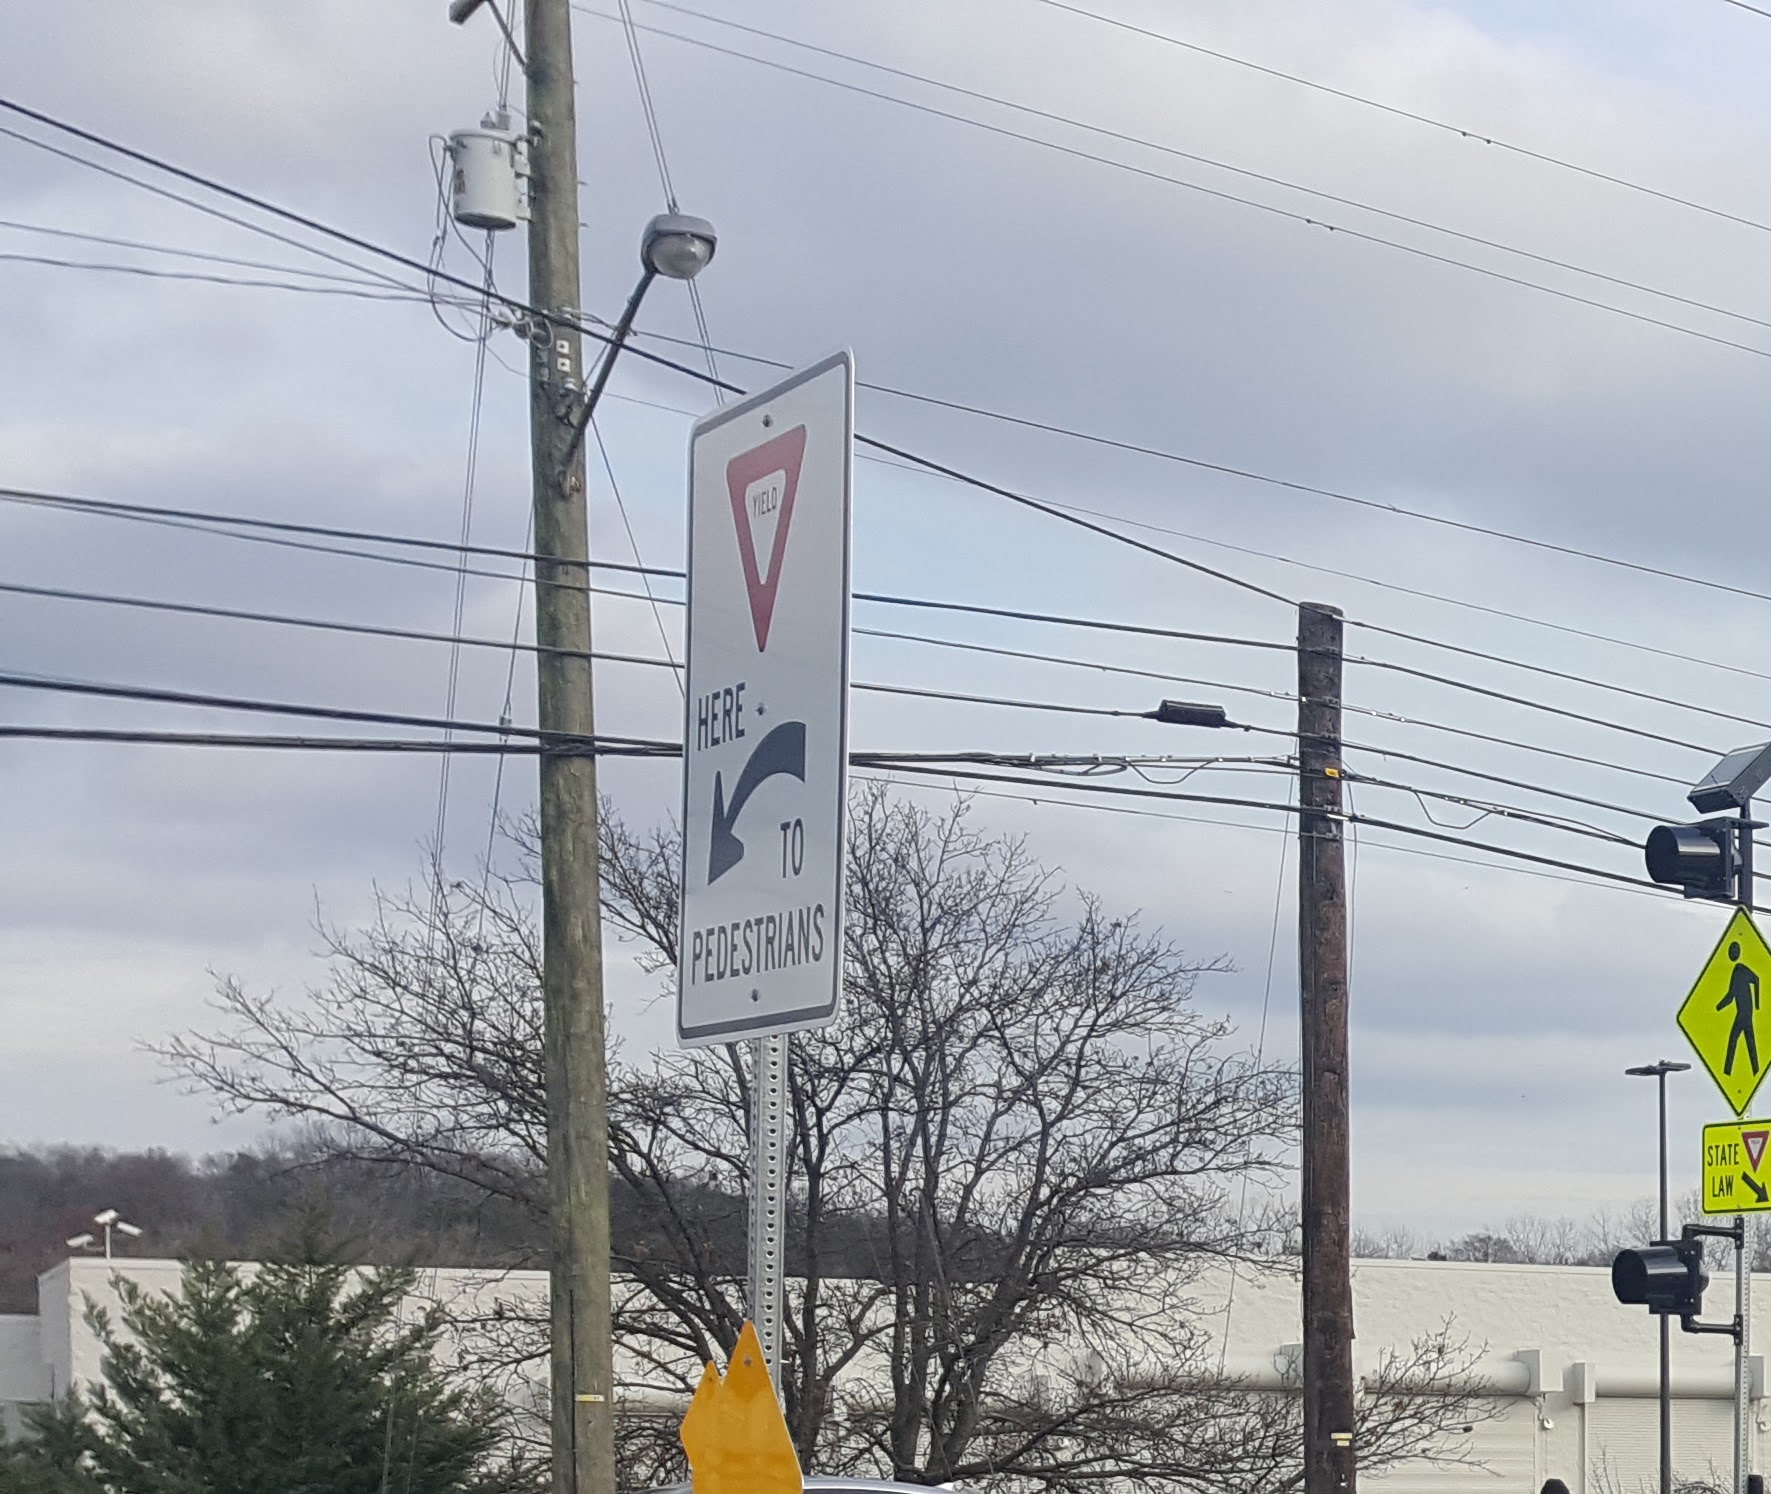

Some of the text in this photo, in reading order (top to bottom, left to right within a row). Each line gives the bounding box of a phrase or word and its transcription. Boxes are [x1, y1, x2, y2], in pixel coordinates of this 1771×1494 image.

[752, 486, 778, 518] YIELD
[696, 681, 746, 752] HERE
[779, 817, 805, 879] TO
[691, 903, 826, 986] PEDESTRIANS
[1707, 1143, 1739, 1167] STATE
[1712, 1175, 1734, 1198] LAW
